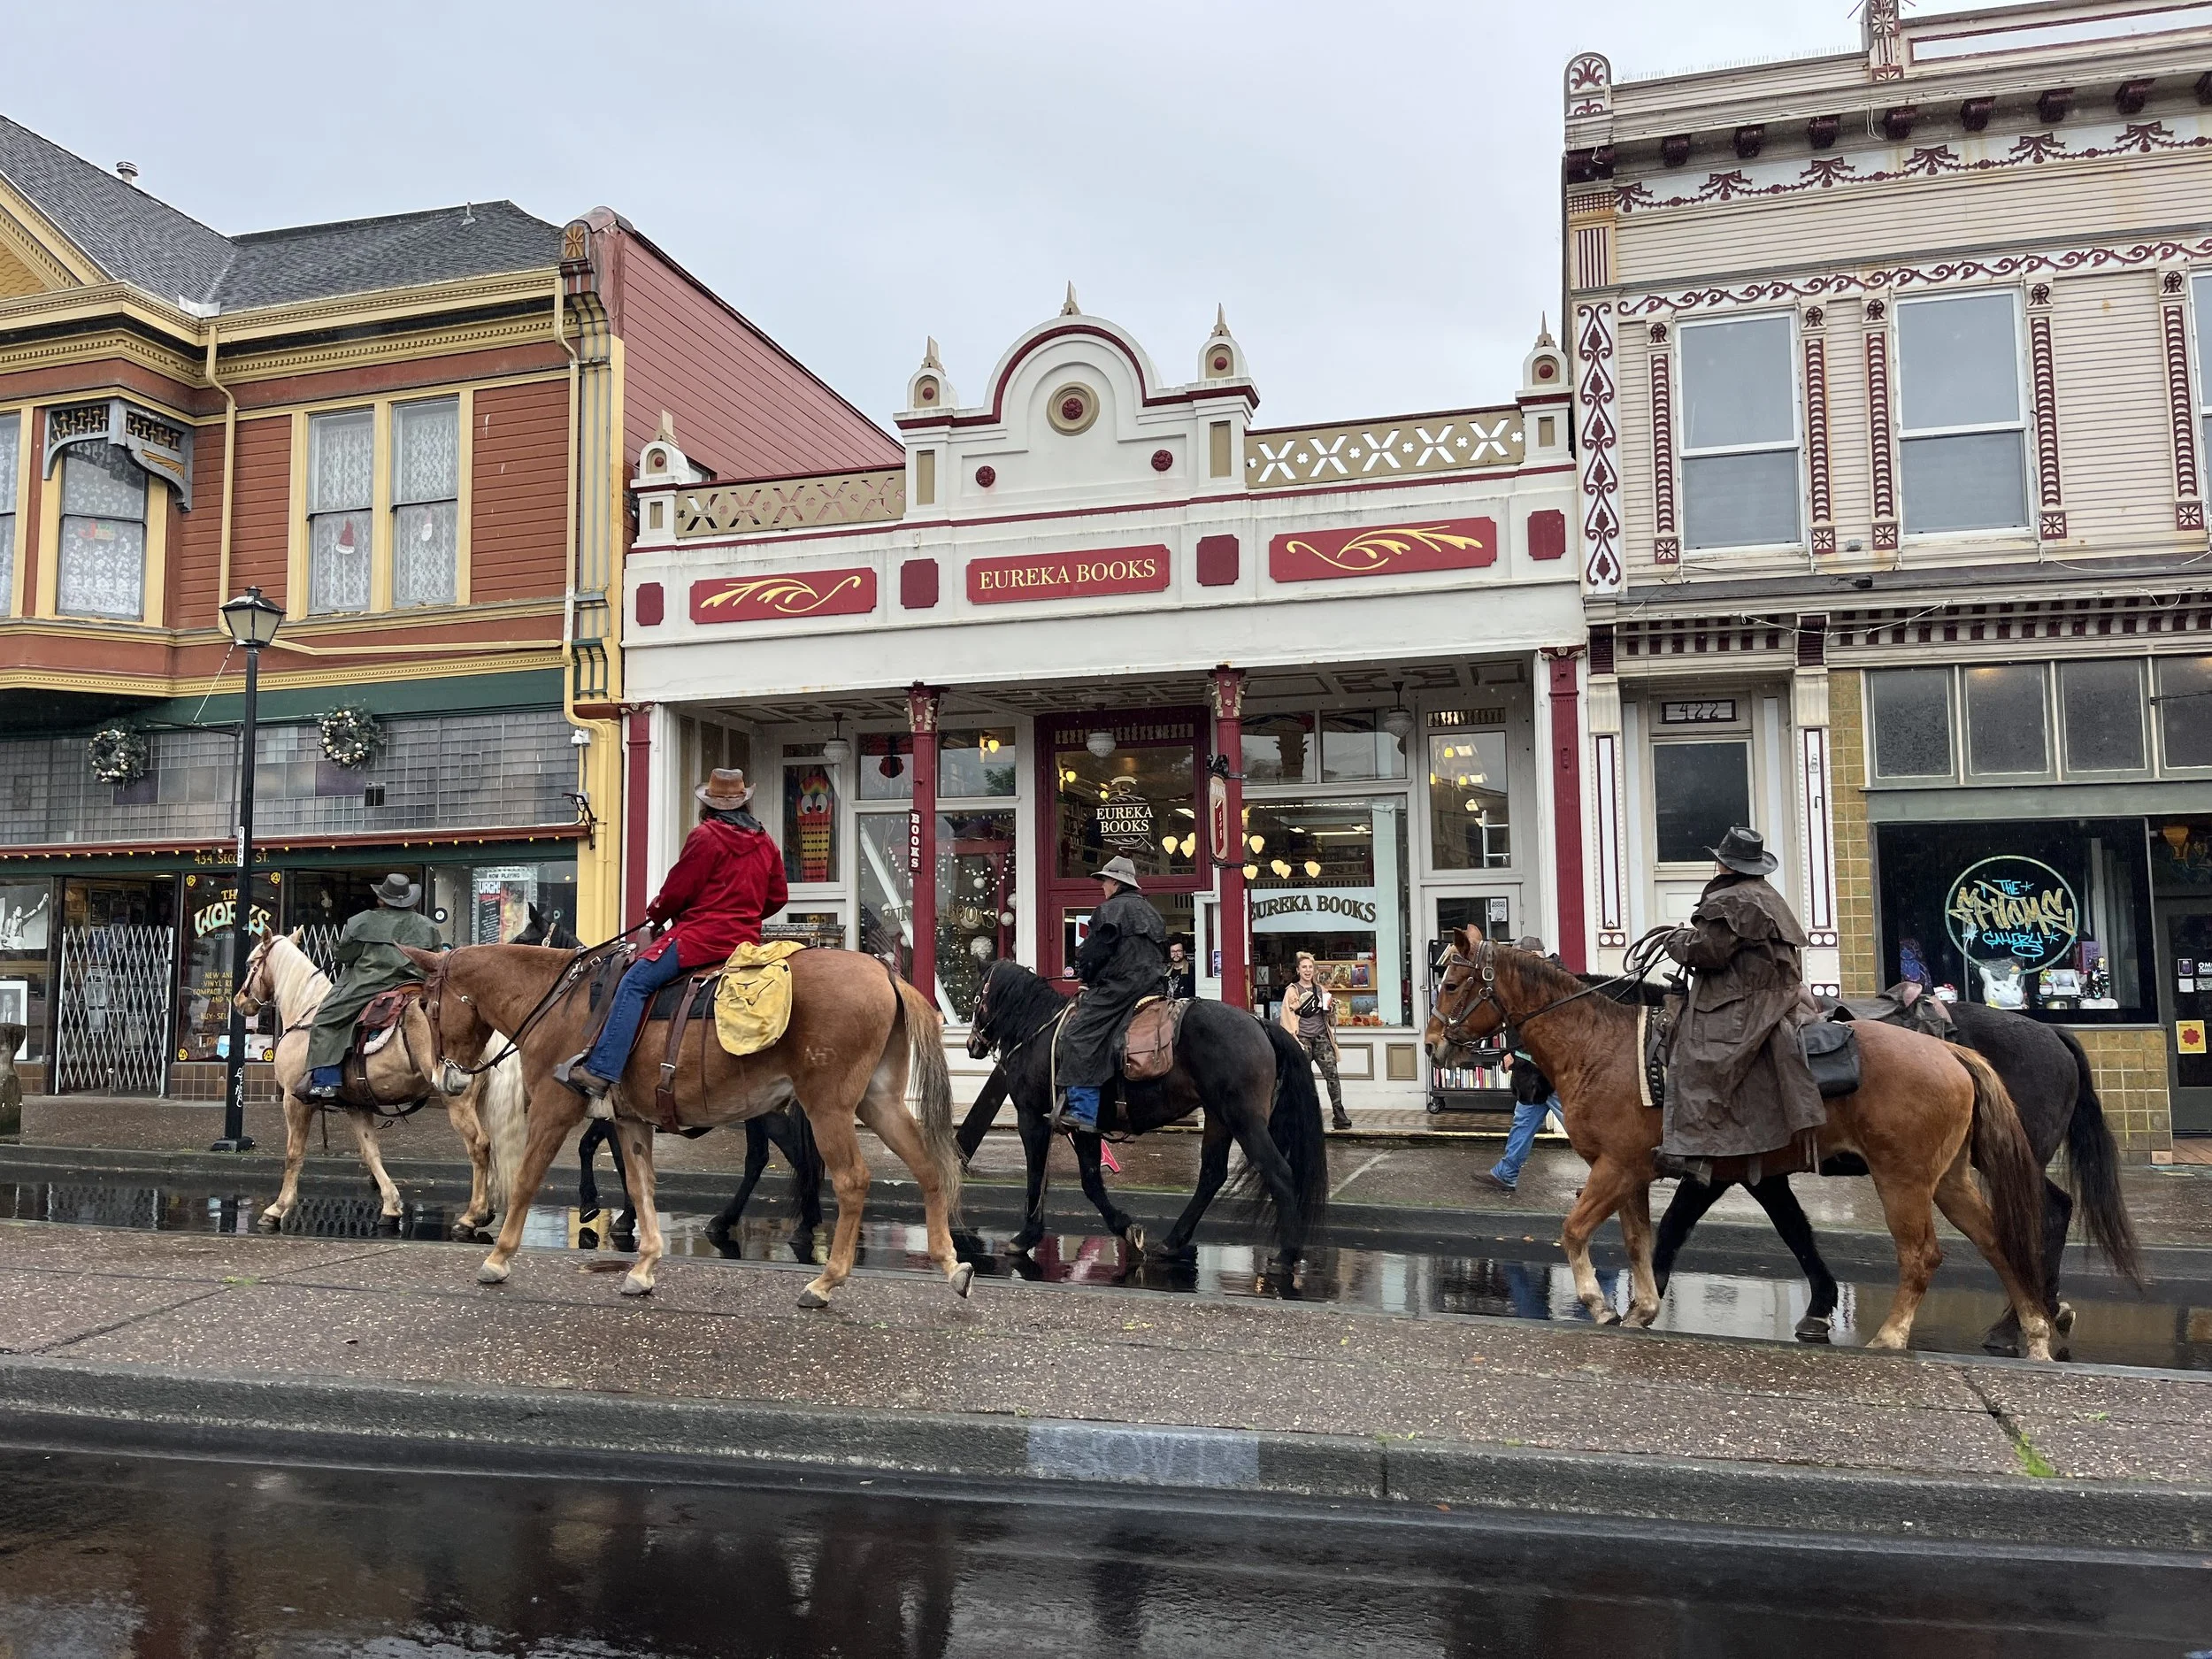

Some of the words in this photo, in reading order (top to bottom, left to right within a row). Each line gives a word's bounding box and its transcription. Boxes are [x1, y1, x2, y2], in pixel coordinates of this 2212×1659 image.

[979, 565, 1071, 590] EUREKA
[1076, 558, 1156, 583] BOOKS
[1679, 703, 1718, 720] 422
[1096, 806, 1154, 820] EUREKA
[1100, 819, 1149, 833] BOOKS
[910, 813, 920, 868] BOOKS
[195, 855, 213, 864] 434
[217, 854, 238, 864] SECO
[255, 853, 270, 863] ST.
[221, 889, 238, 901] TH
[479, 881, 501, 894] URGH!
[946, 902, 996, 929] BOOKS
[1250, 895, 1313, 921] EUREKA
[1317, 895, 1377, 923] BOOKS
